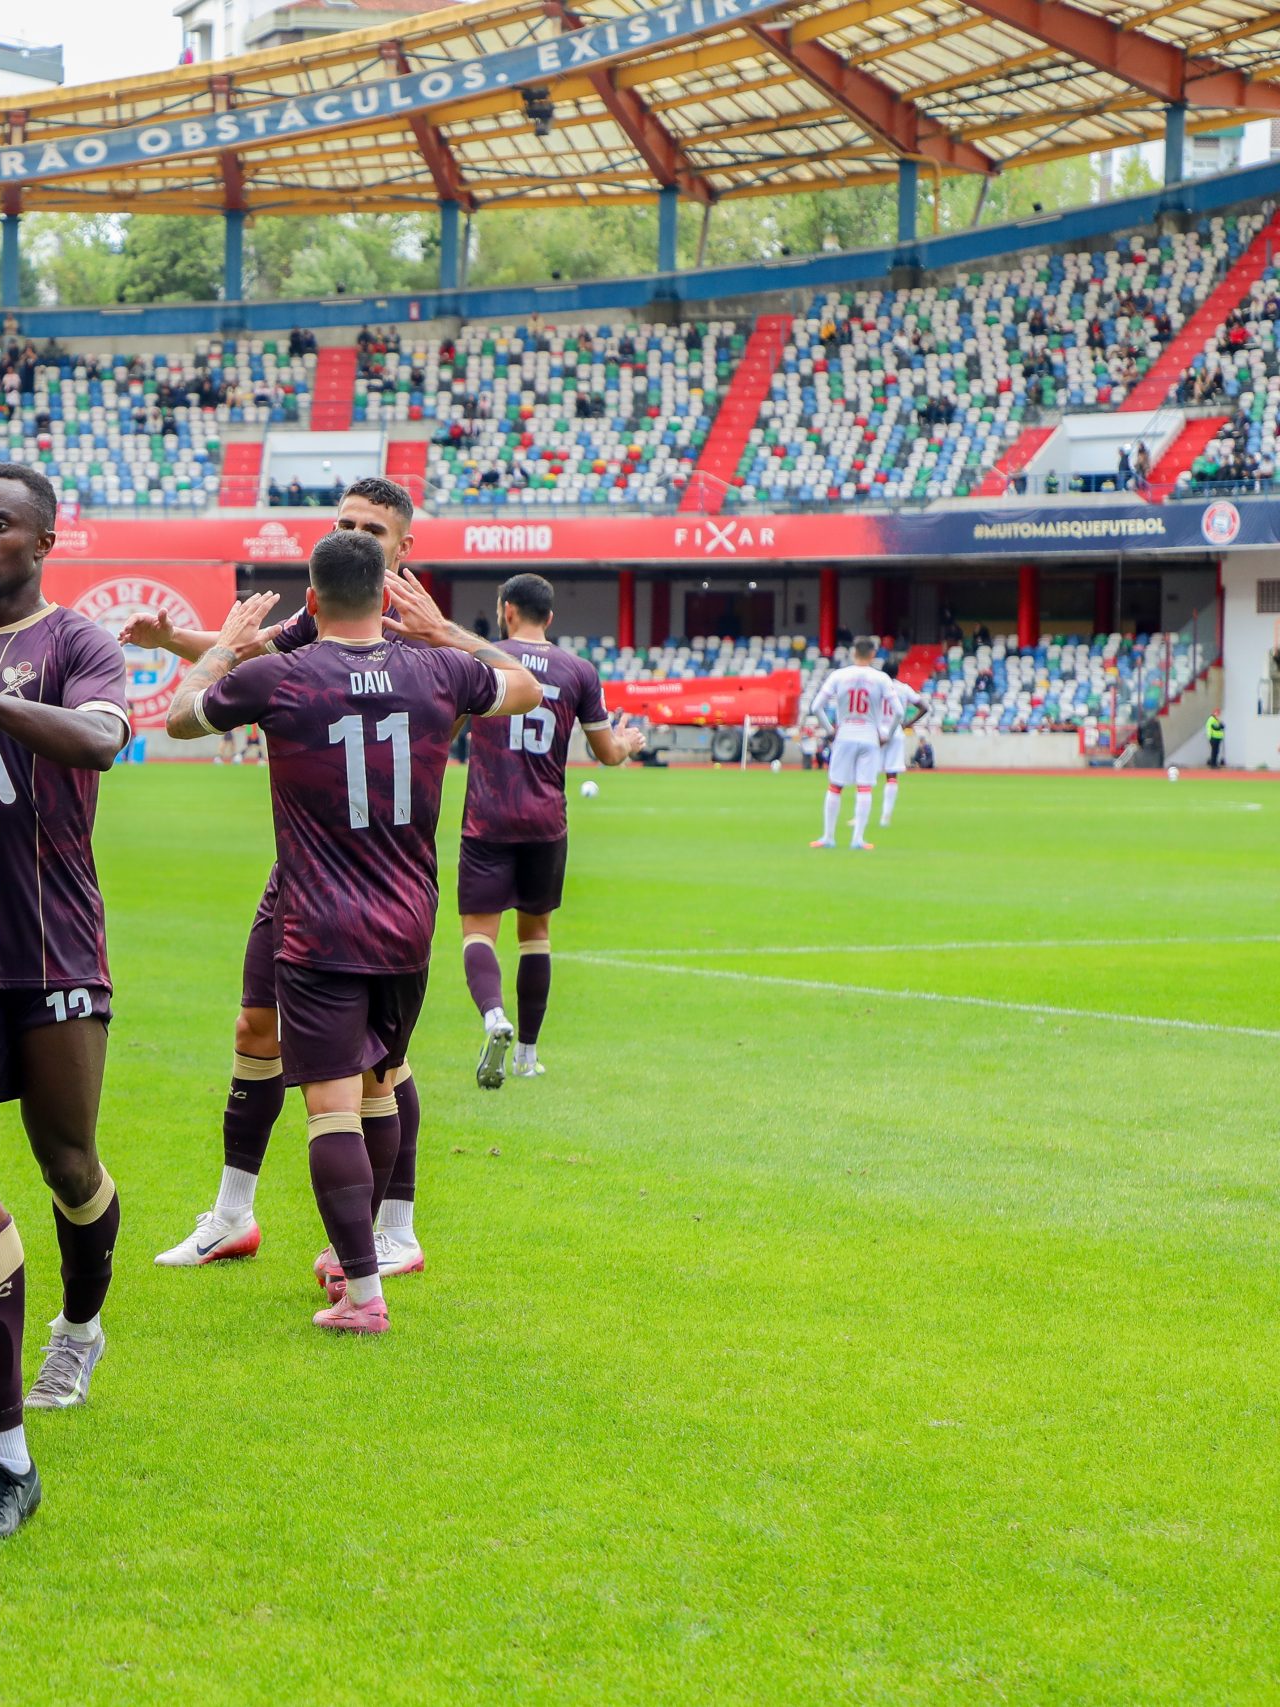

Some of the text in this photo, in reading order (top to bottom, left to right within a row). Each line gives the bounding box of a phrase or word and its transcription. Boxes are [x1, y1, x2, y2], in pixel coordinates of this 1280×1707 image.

[137, 61, 509, 155] OBSTÁCULOS.
[537, 0, 765, 72] EXISTIR
[674, 520, 776, 553] FIXAR
[974, 517, 1167, 540] #MUITOMAISQUEFUTEBOL
[521, 653, 548, 673] DAVI
[349, 670, 393, 695] DAVI
[847, 687, 870, 715] 16
[328, 711, 412, 829] 11
